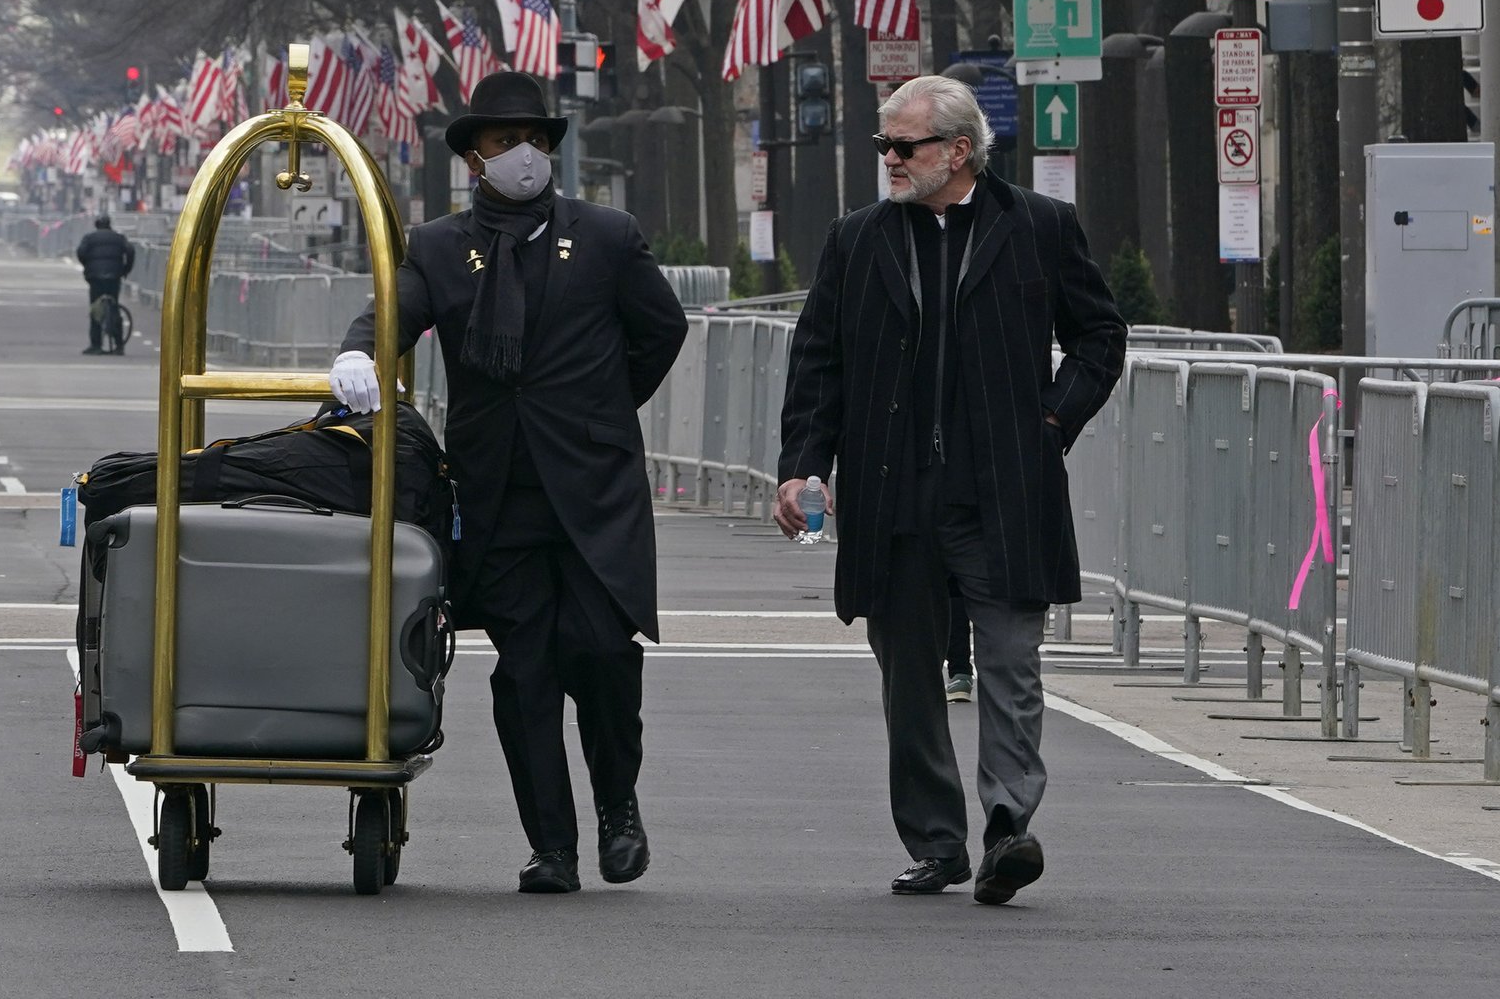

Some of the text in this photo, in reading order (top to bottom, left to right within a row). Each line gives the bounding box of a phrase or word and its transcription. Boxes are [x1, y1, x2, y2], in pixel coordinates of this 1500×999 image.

[872, 43, 883, 52] NO
[1221, 50, 1255, 58] STANDING
[1223, 112, 1233, 125] NO
